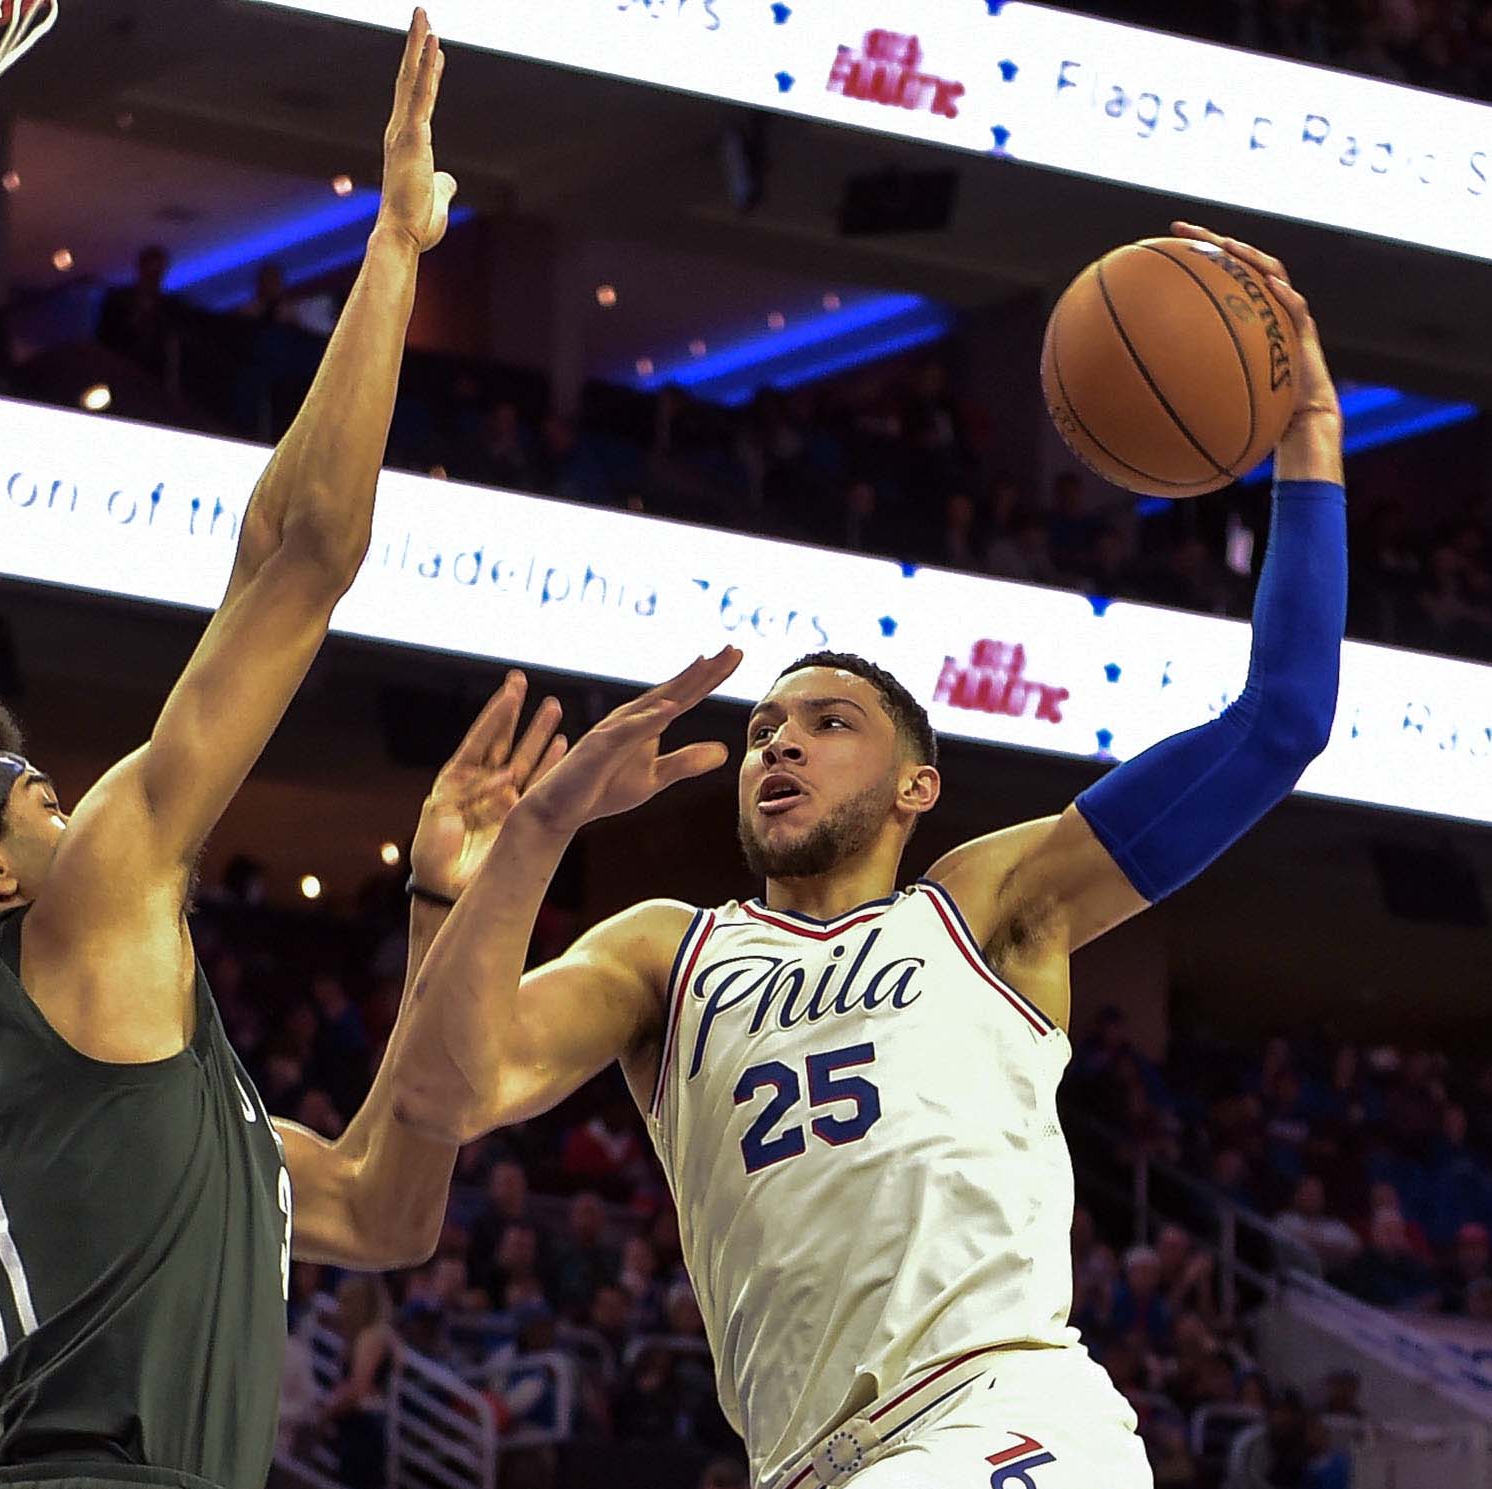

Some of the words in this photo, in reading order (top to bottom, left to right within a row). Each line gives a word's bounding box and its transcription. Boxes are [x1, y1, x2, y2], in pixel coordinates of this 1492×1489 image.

[108, 482, 164, 526] of
[191, 497, 236, 540] th
[366, 533, 658, 617] iladelphia
[688, 927, 925, 1081] Phila
[732, 1041, 883, 1175] 25
